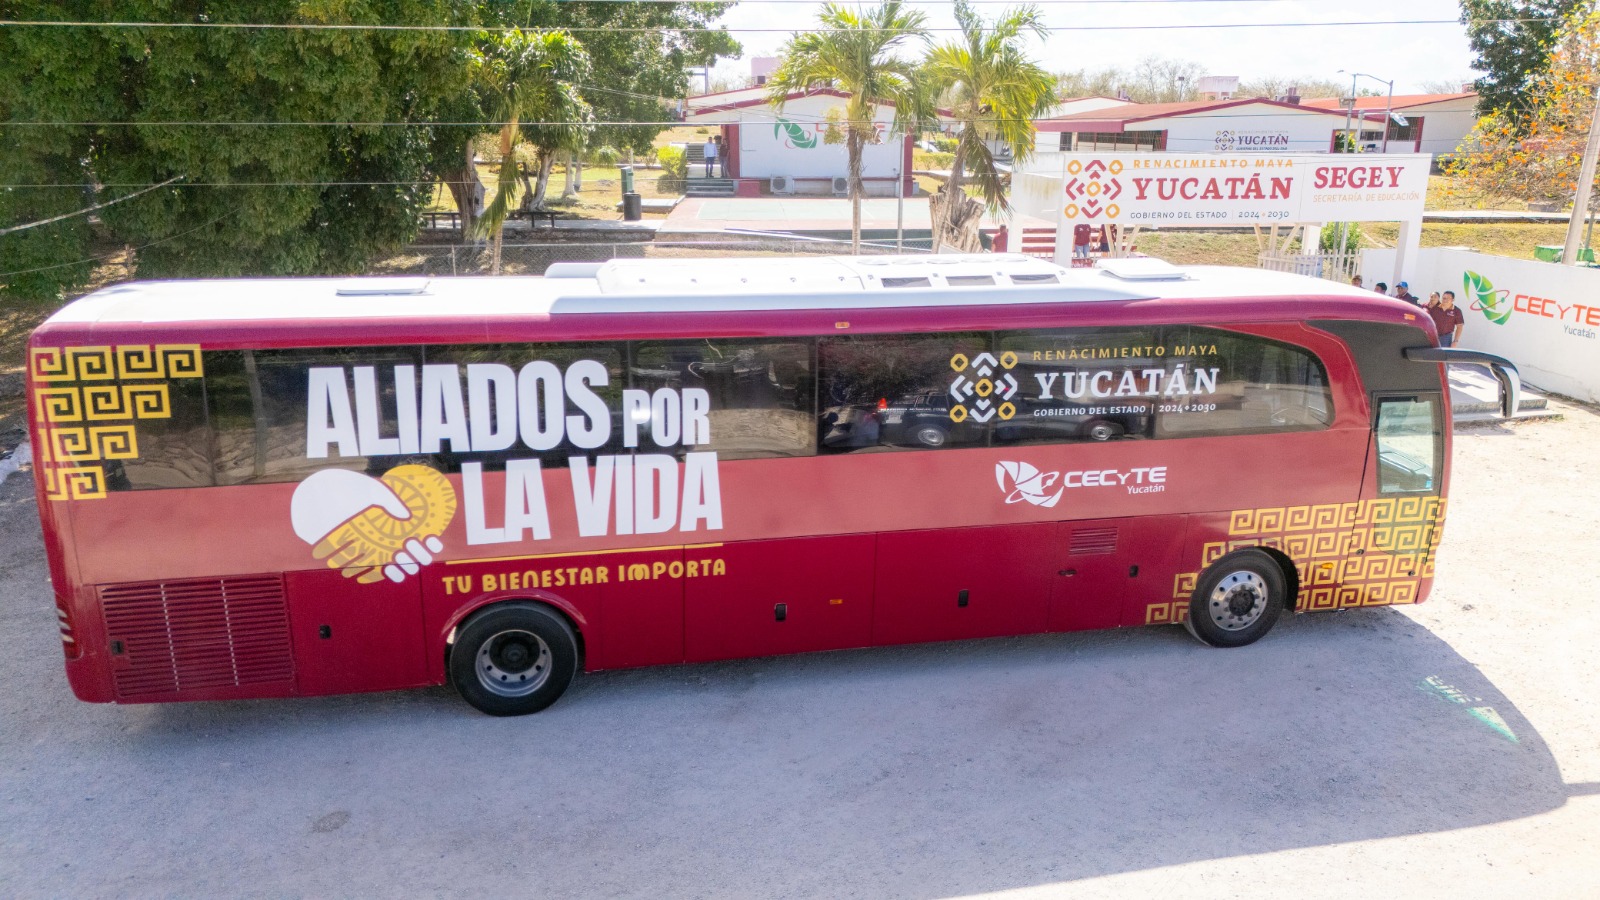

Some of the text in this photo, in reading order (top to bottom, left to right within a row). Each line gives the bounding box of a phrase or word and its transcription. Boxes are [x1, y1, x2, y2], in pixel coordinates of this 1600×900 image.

[1238, 133, 1289, 145] YUCATÁN
[1133, 158, 1294, 169] RENACIMIENTO MAYA
[1314, 166, 1405, 189] SEGEY
[1132, 172, 1294, 201] YUCATÁN
[1313, 190, 1420, 203] SECRETARÍA DE EDUCACIÓN
[1130, 211, 1290, 220] GOBIERNO DEL ESTADO 2024 2030
[1563, 324, 1596, 339] Yucatán
[1033, 344, 1218, 361] RENACIMIENTO MAYA
[1033, 363, 1220, 400] YUCATÁN
[306, 359, 711, 458] ALIADOS POR
[1033, 403, 1217, 417] GOBIERNO DEL ESTADO 2024 2030
[1127, 484, 1165, 495] Yucatán
[460, 451, 724, 546] LA VIDA
[442, 558, 727, 595] TU BIENESTAR IMPORTA
